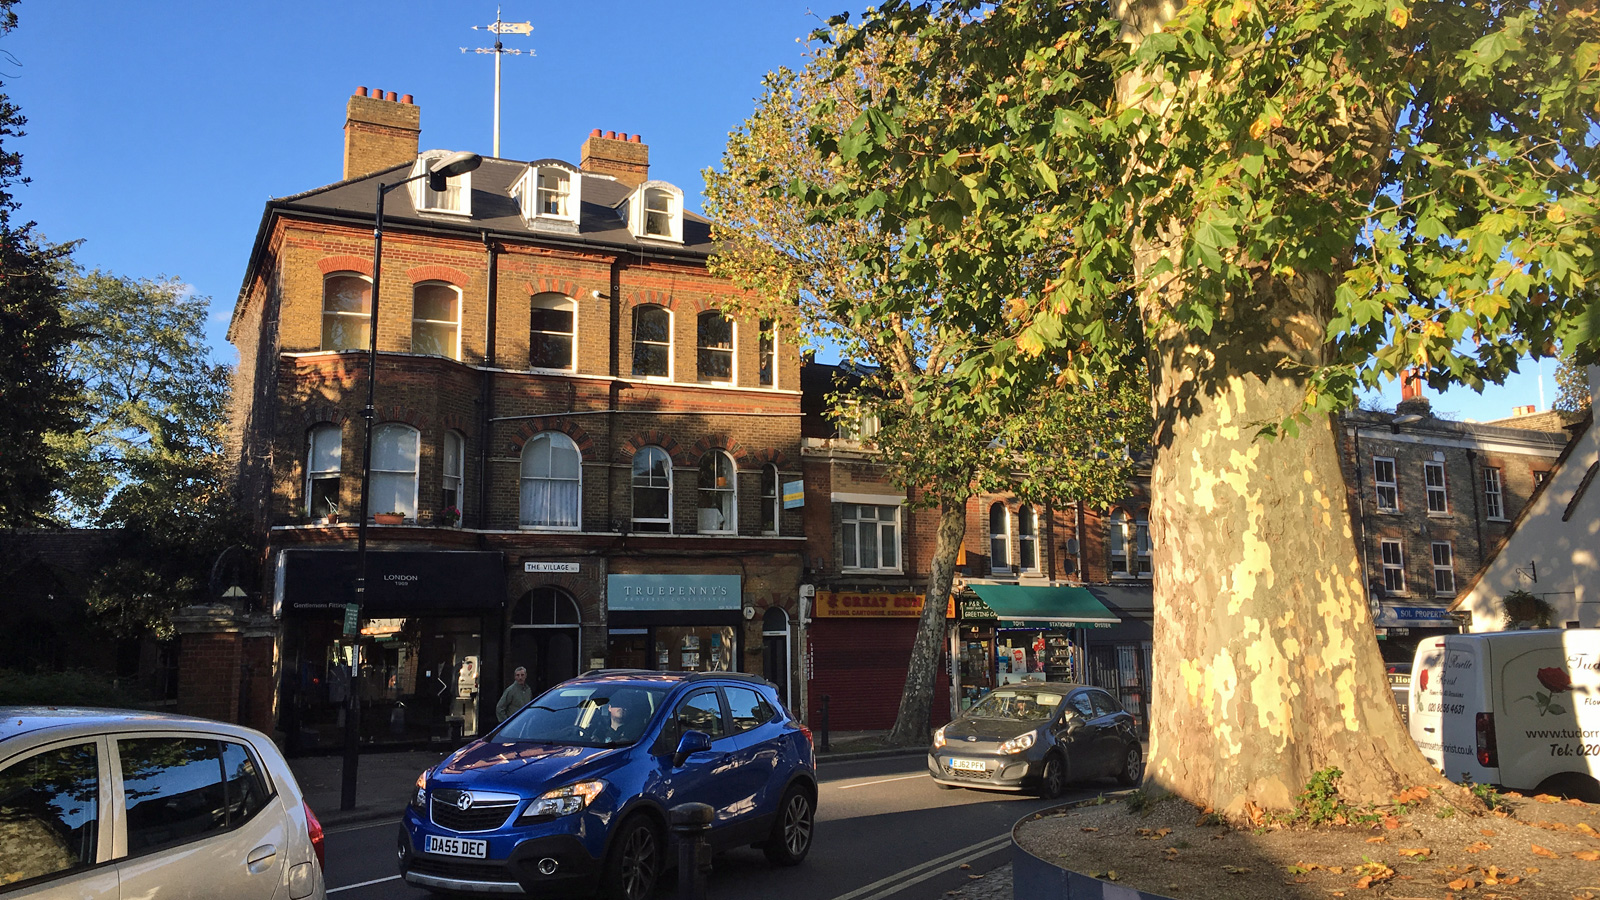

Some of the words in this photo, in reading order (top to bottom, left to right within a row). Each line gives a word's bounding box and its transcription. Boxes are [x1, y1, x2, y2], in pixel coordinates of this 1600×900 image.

[530, 49, 537, 57] E
[527, 563, 541, 571] THE
[624, 585, 727, 596] TRUEPENNY'S
[842, 596, 888, 608] GREAT
[893, 597, 922, 608] SUN
[1400, 610, 1413, 618] SOL
[1525, 728, 1600, 739] www.tudorr
[1549, 743, 1573, 757] Tel:
[953, 760, 970, 769] EJ62
[971, 761, 985, 770] PFK
[431, 837, 459, 854] DA55
[461, 841, 484, 856] DEC
